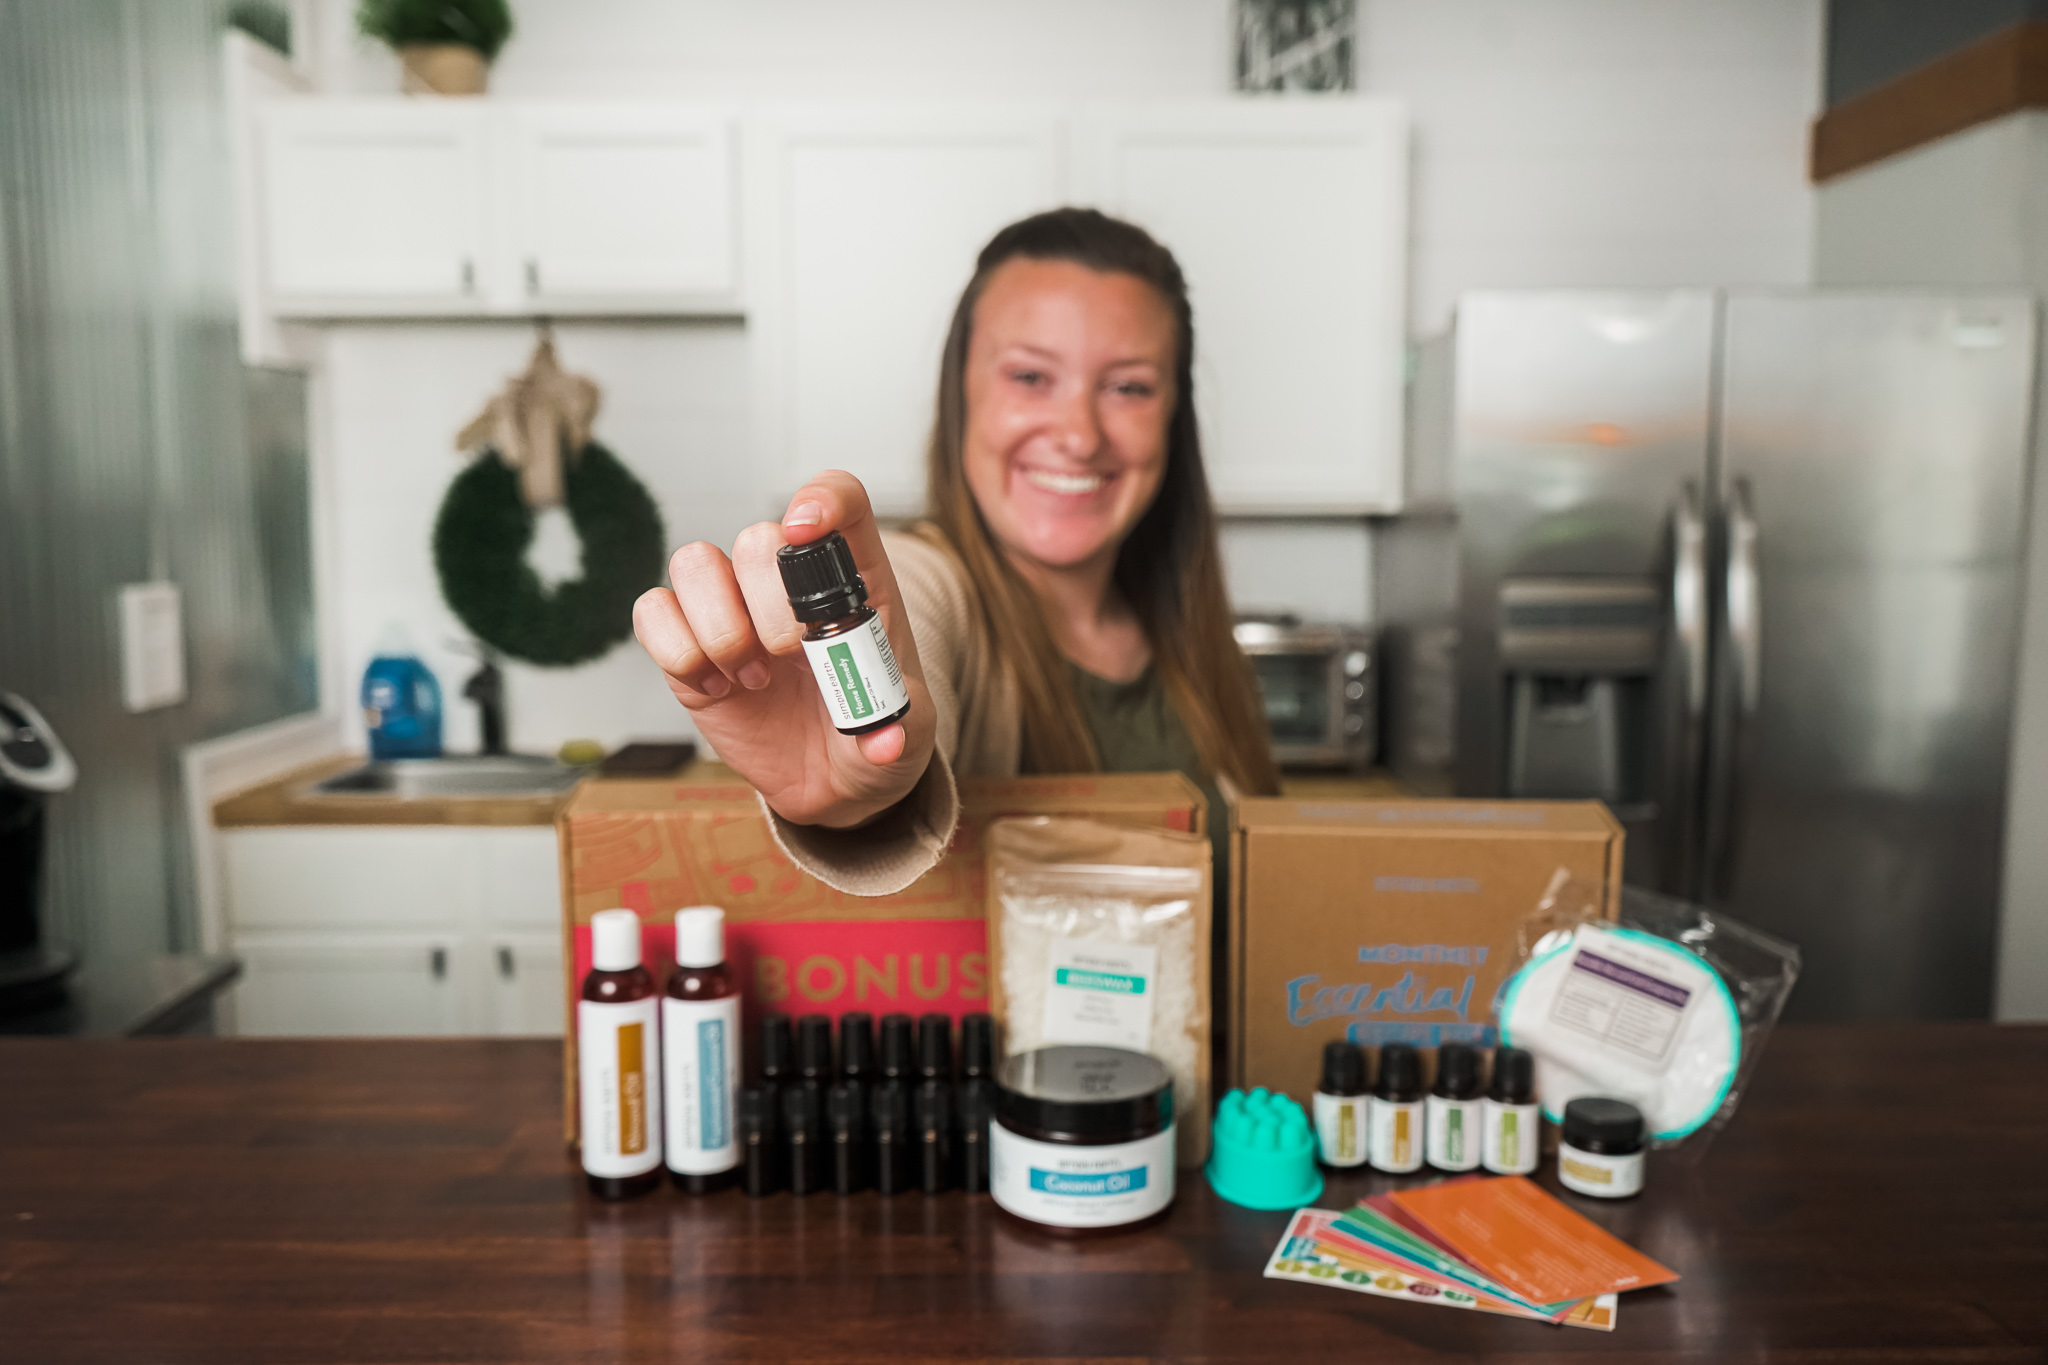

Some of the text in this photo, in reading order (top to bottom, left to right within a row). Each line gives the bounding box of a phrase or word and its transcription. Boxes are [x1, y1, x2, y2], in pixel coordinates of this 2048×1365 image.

[823, 661, 851, 720] simply earth
[839, 658, 866, 715] Home Remedy
[756, 951, 990, 1003] BONUS
[1286, 971, 1476, 1027] Essential
[1043, 1173, 1131, 1194] Coconut Oil
